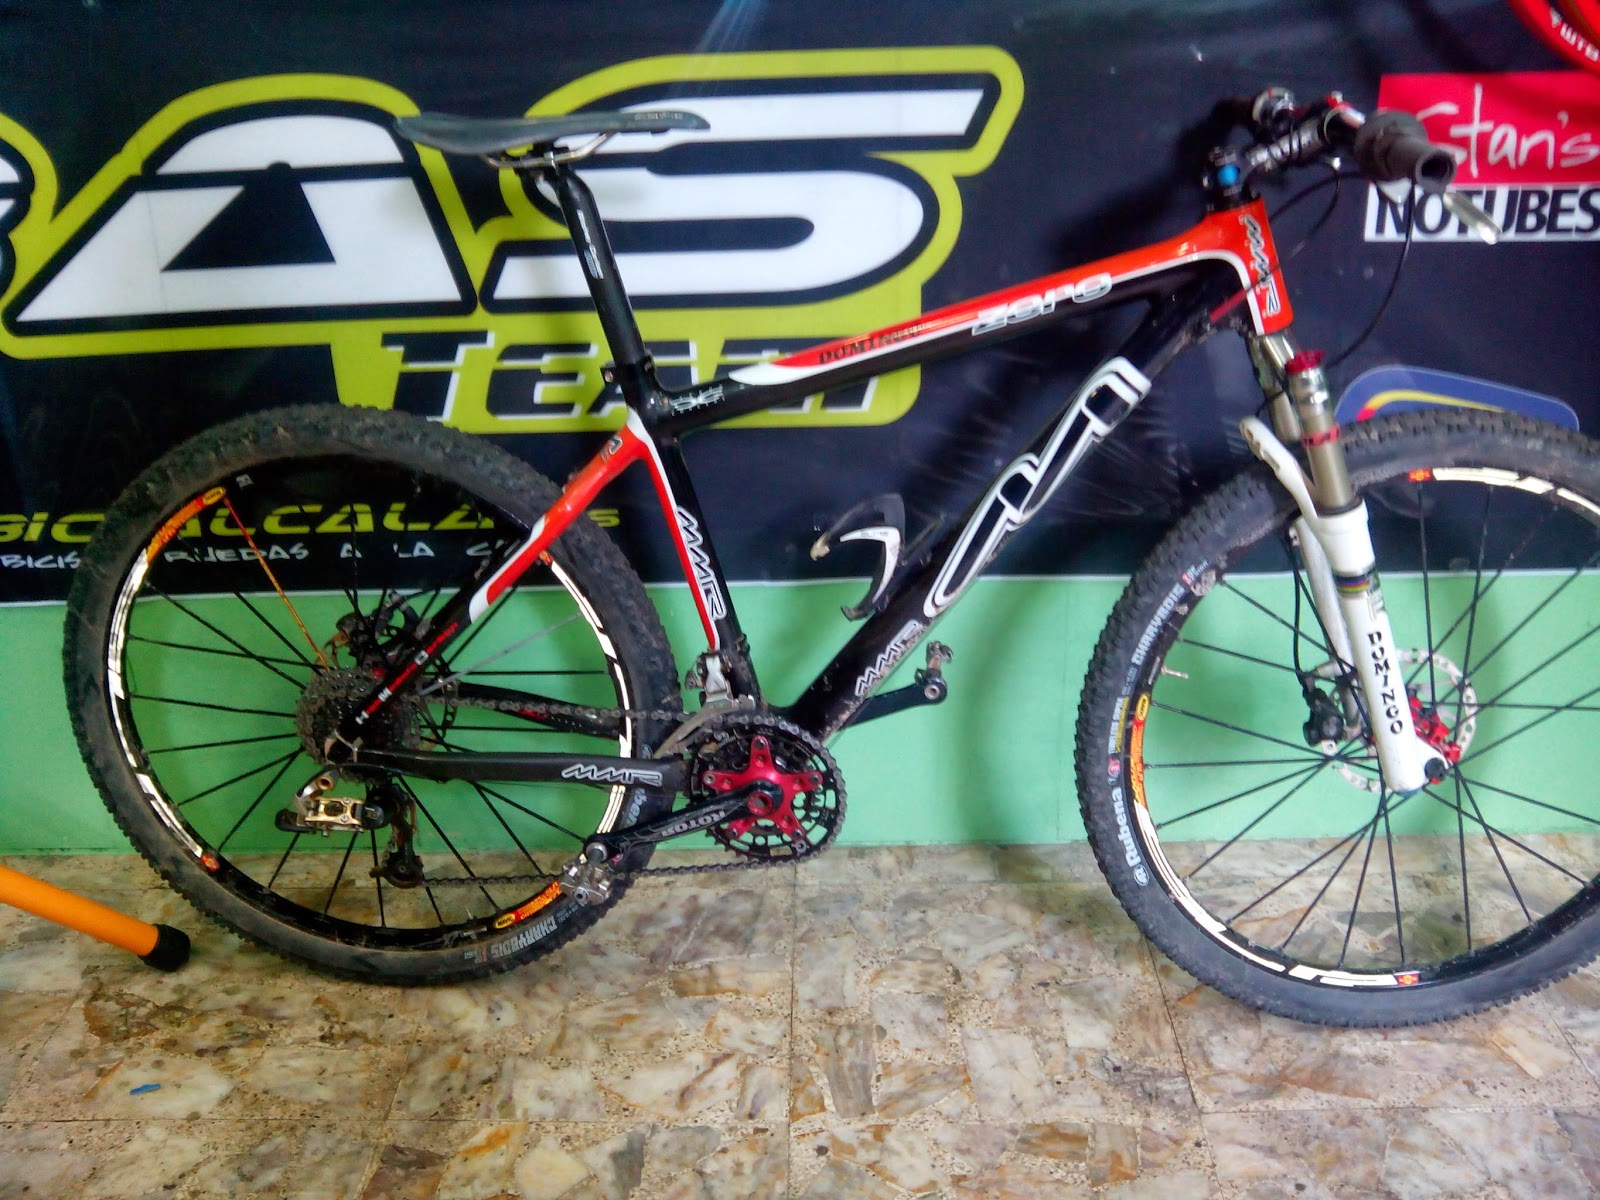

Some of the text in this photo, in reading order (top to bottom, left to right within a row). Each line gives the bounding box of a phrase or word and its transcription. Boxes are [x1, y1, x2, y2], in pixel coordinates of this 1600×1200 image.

[0, 88, 987, 322] AS
[0, 551, 81, 569] BICIS
[1368, 631, 1404, 735] DOMINGO
[1112, 786, 1142, 867] Rubena
